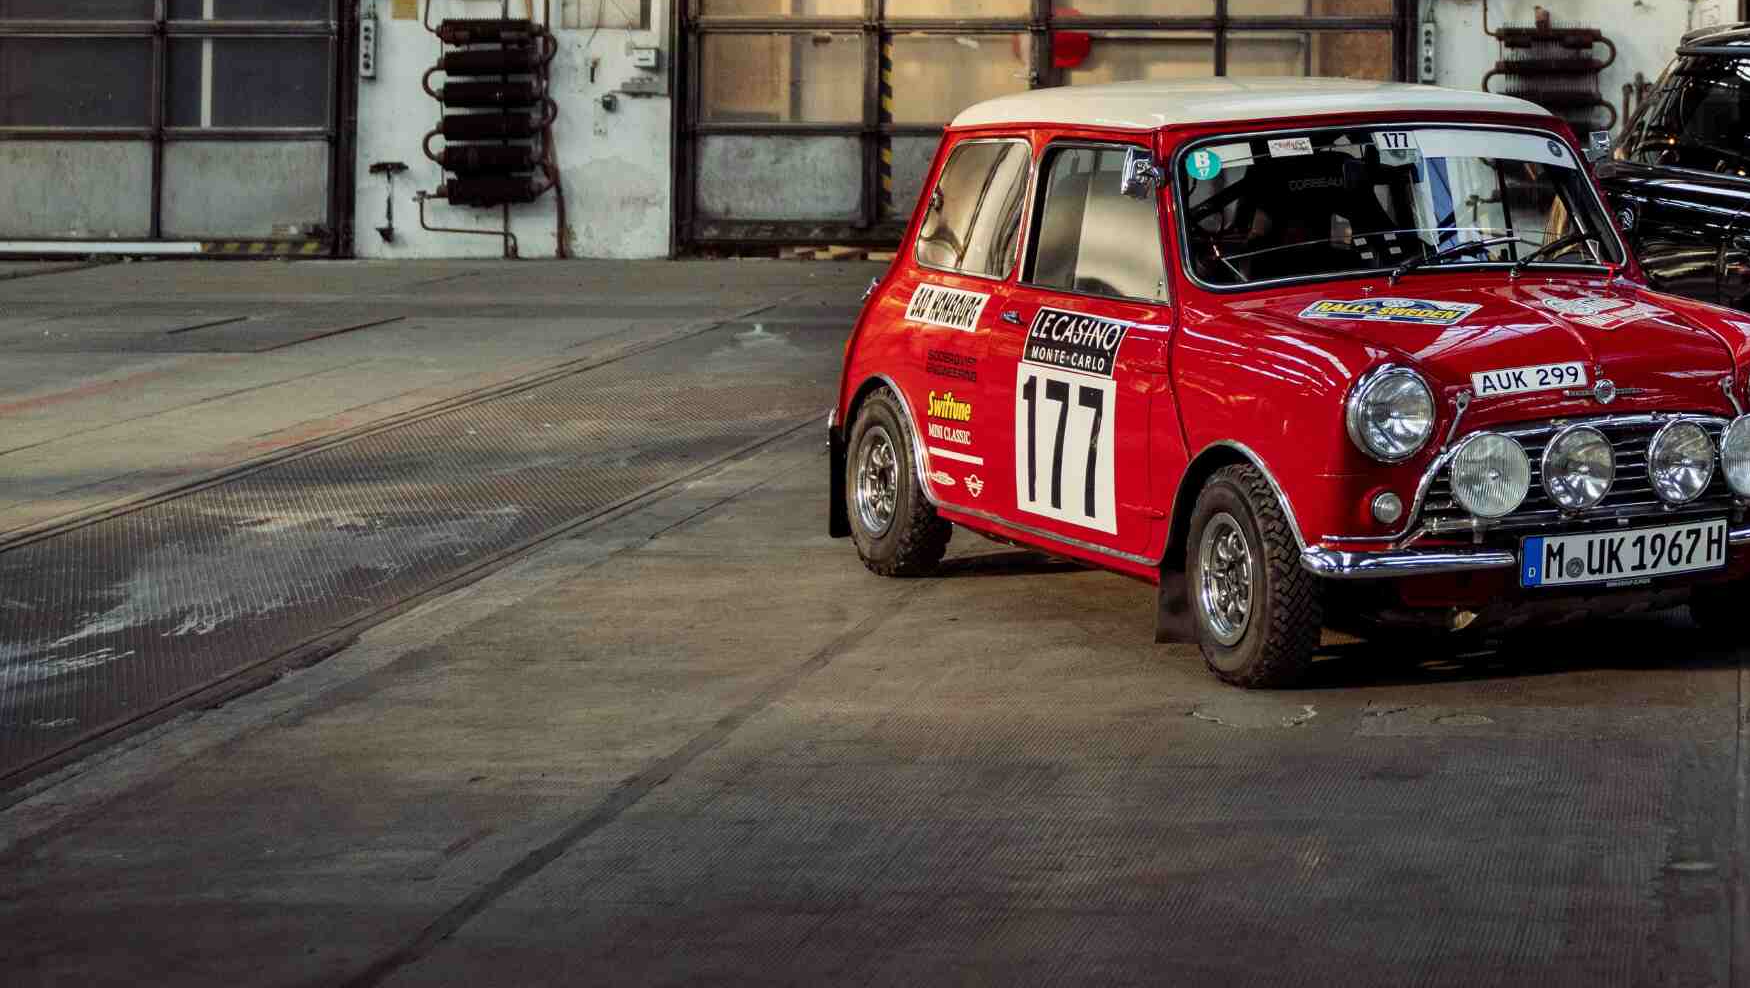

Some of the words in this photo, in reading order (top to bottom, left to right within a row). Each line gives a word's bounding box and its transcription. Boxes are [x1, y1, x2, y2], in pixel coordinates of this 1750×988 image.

[1382, 132, 1409, 148] 177
[1193, 151, 1210, 169] B
[909, 287, 935, 318] BAD
[1316, 302, 1375, 314] RALLY
[1377, 307, 1461, 320] SWEDEN
[1051, 313, 1122, 351] CASINO
[1481, 370, 1529, 394] AUK
[1535, 365, 1580, 387] 299
[927, 390, 972, 422] Swiftune
[928, 422, 944, 440] MINI
[943, 426, 972, 446] CLASSIC
[1022, 374, 1104, 519] 177
[1545, 541, 1565, 580] M
[1586, 536, 1626, 576] UK
